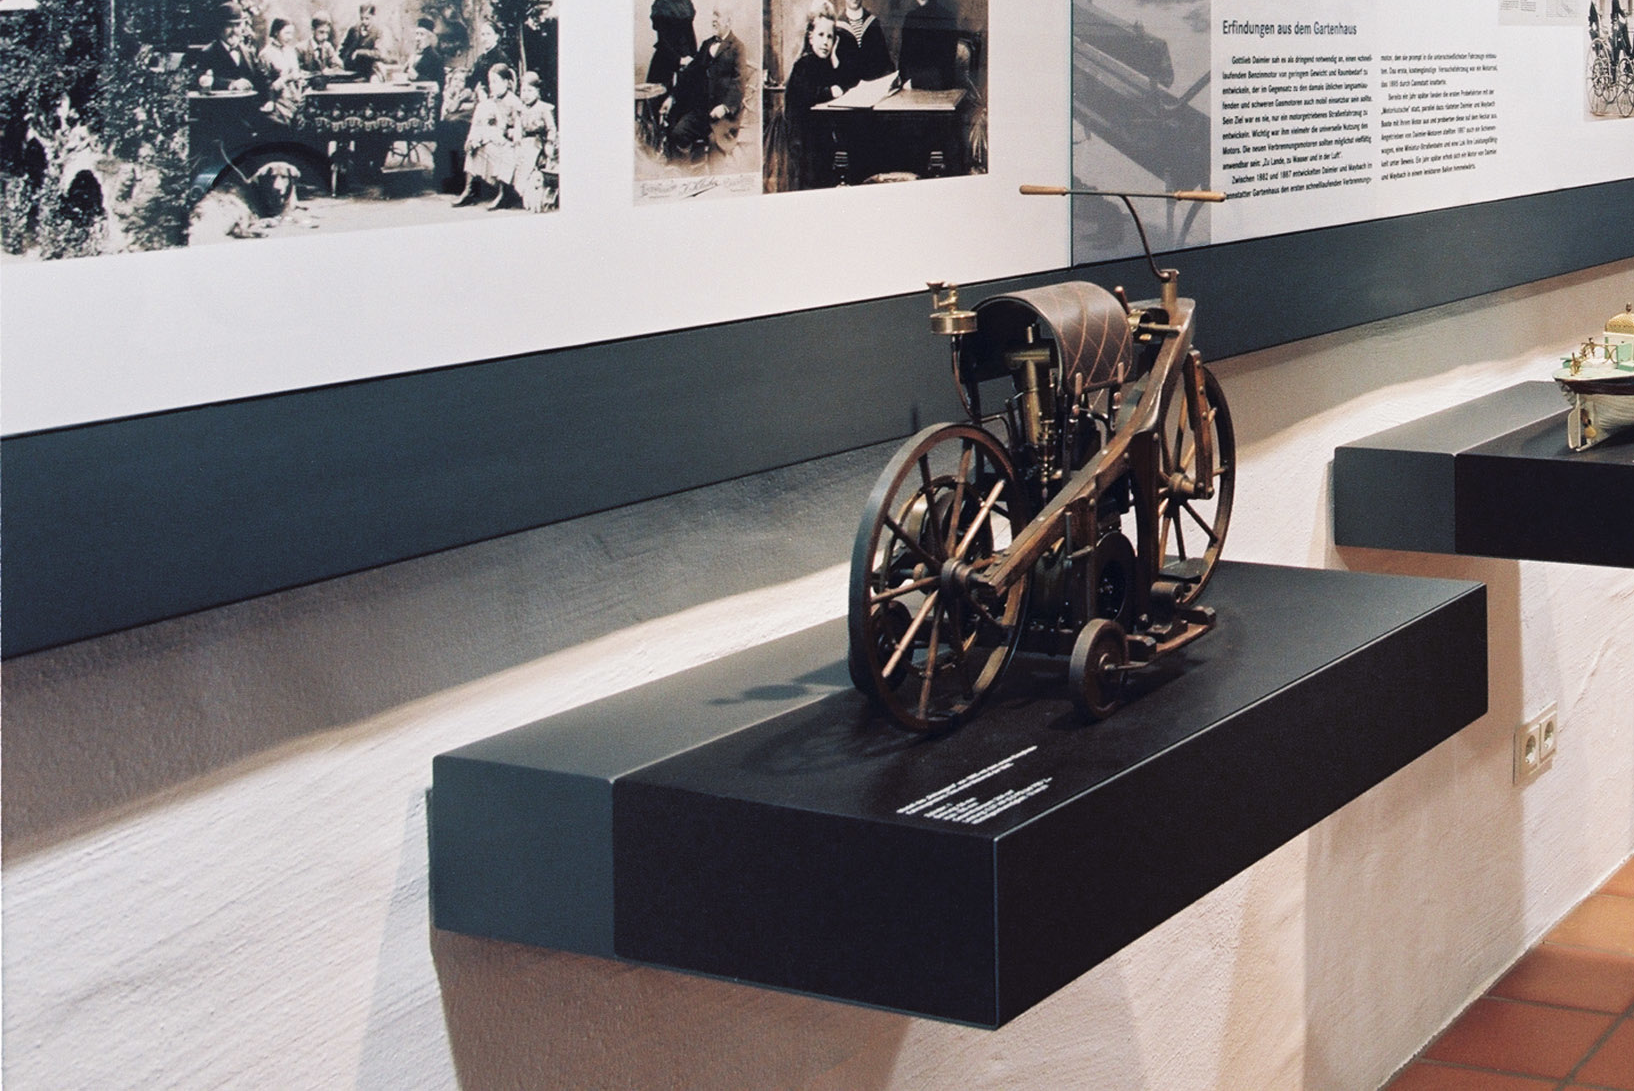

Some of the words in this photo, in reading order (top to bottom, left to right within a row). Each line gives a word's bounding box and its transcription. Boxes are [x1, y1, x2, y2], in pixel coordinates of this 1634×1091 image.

[1223, 20, 1274, 39] Erfindungen
[1278, 24, 1292, 35] aus
[1294, 22, 1311, 35] dem
[1314, 21, 1356, 35] Gartenhaus
